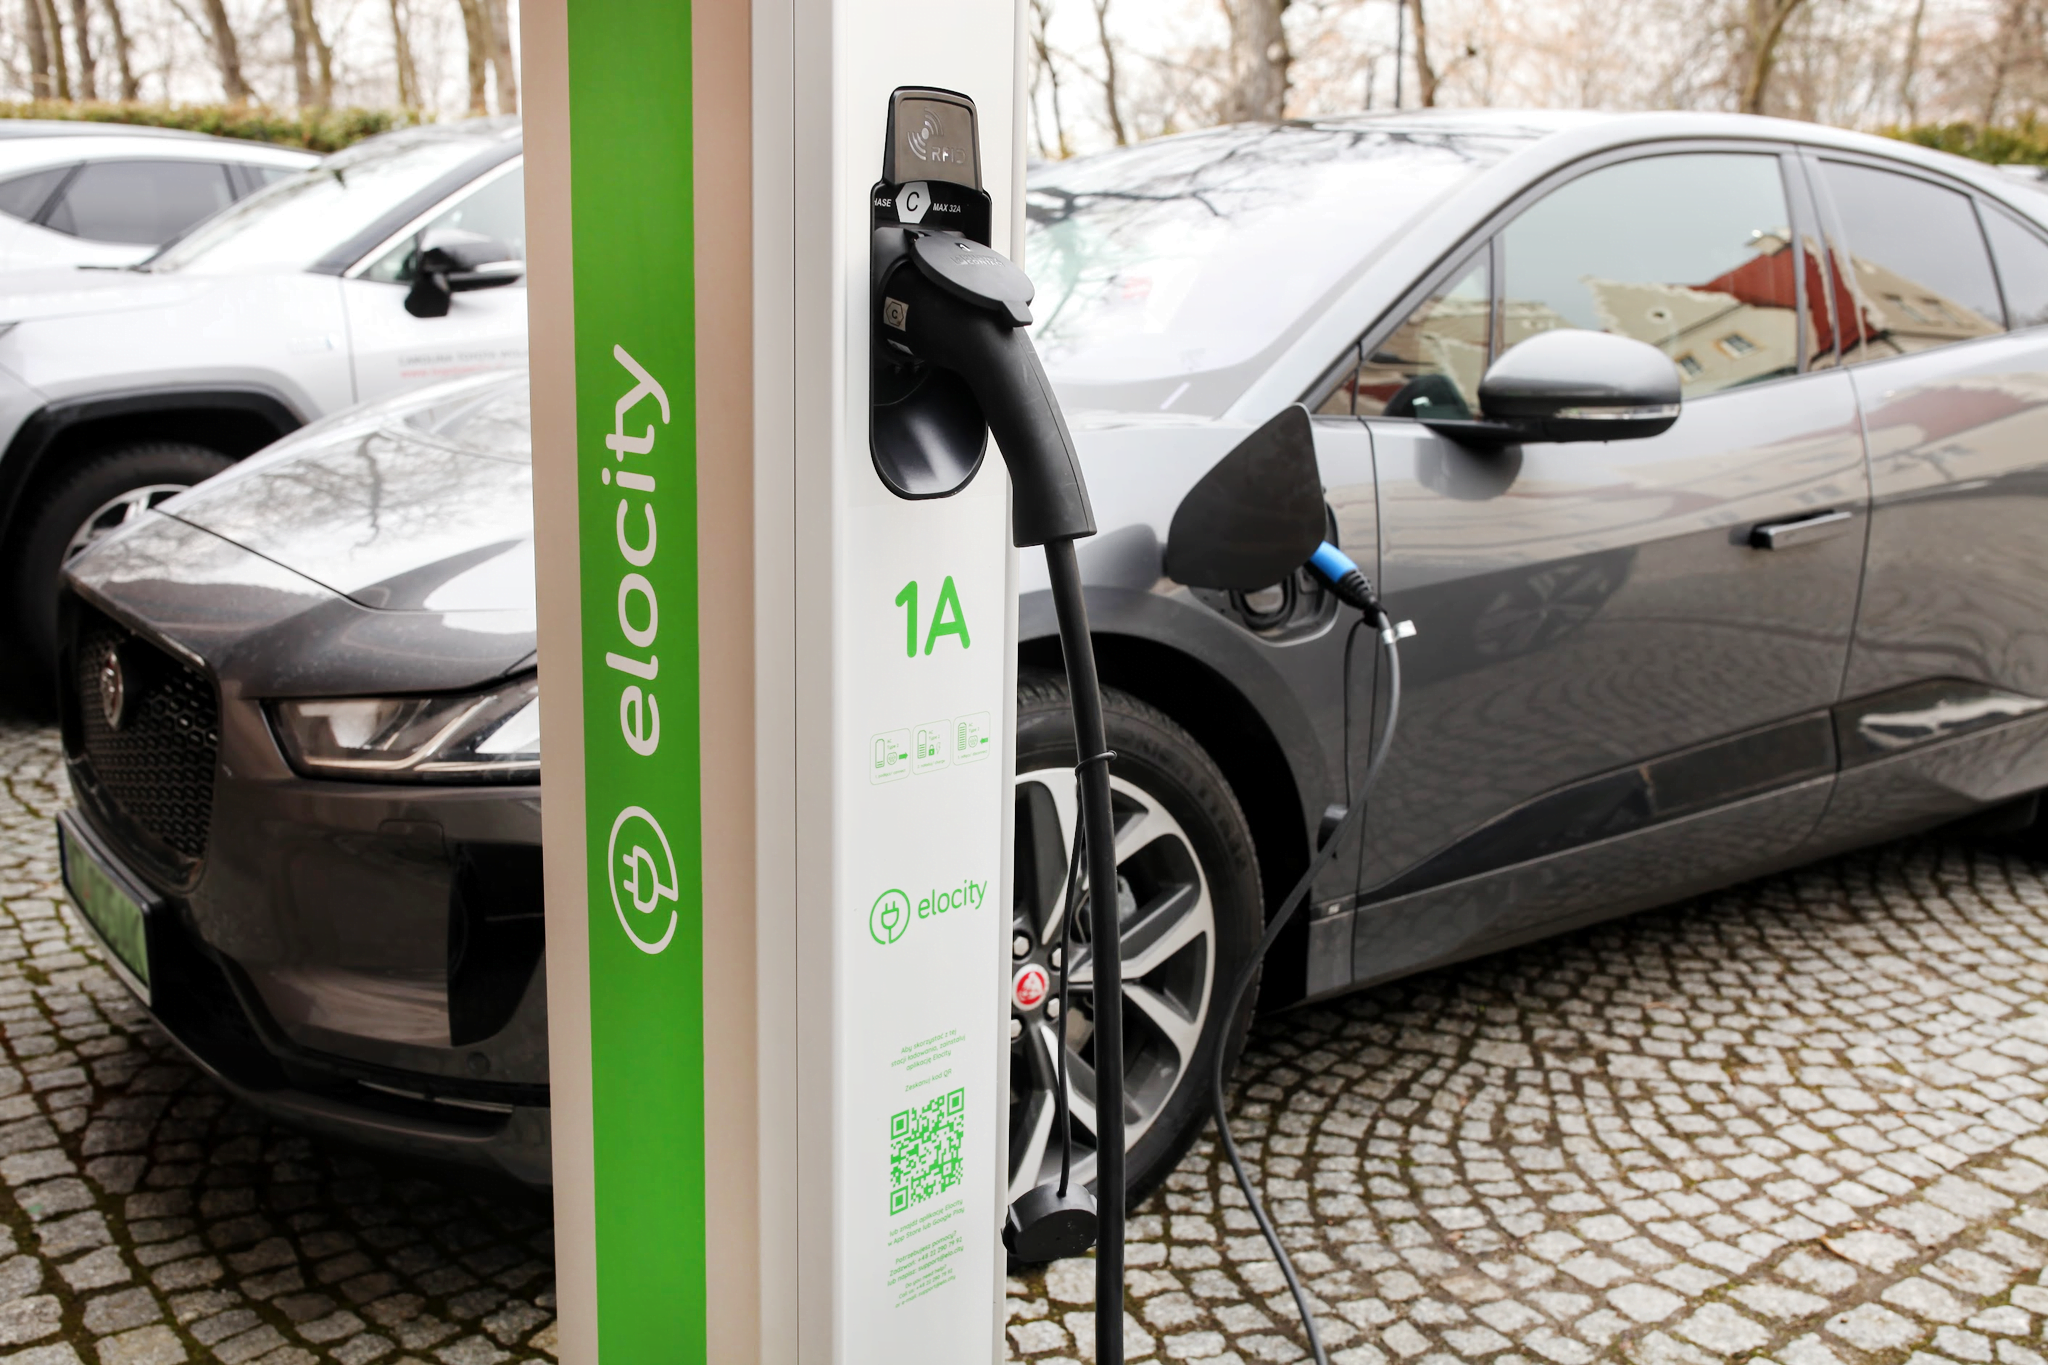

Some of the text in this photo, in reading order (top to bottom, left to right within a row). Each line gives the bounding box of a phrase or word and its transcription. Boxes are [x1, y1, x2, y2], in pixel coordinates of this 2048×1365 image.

[931, 146, 966, 164] RFID
[906, 191, 920, 212] C
[933, 203, 949, 212] MAX
[949, 204, 961, 213] 32A
[891, 309, 898, 319] C
[601, 343, 671, 758] elocity
[894, 574, 971, 658] 1A
[918, 879, 987, 919] elocity
[891, 1056, 906, 1067] stacji
[940, 1034, 965, 1049] zainstaluj
[901, 1046, 912, 1054] Aby
[914, 1033, 943, 1049] skorzystać
[906, 1050, 951, 1071] aplikację Elocity
[905, 1068, 952, 1092] Zeskanuj kod QR
[894, 1235, 905, 1244] App
[906, 1227, 921, 1238] Store
[923, 1222, 931, 1230] lub
[932, 1213, 952, 1225] Google
[953, 1207, 965, 1217] Play
